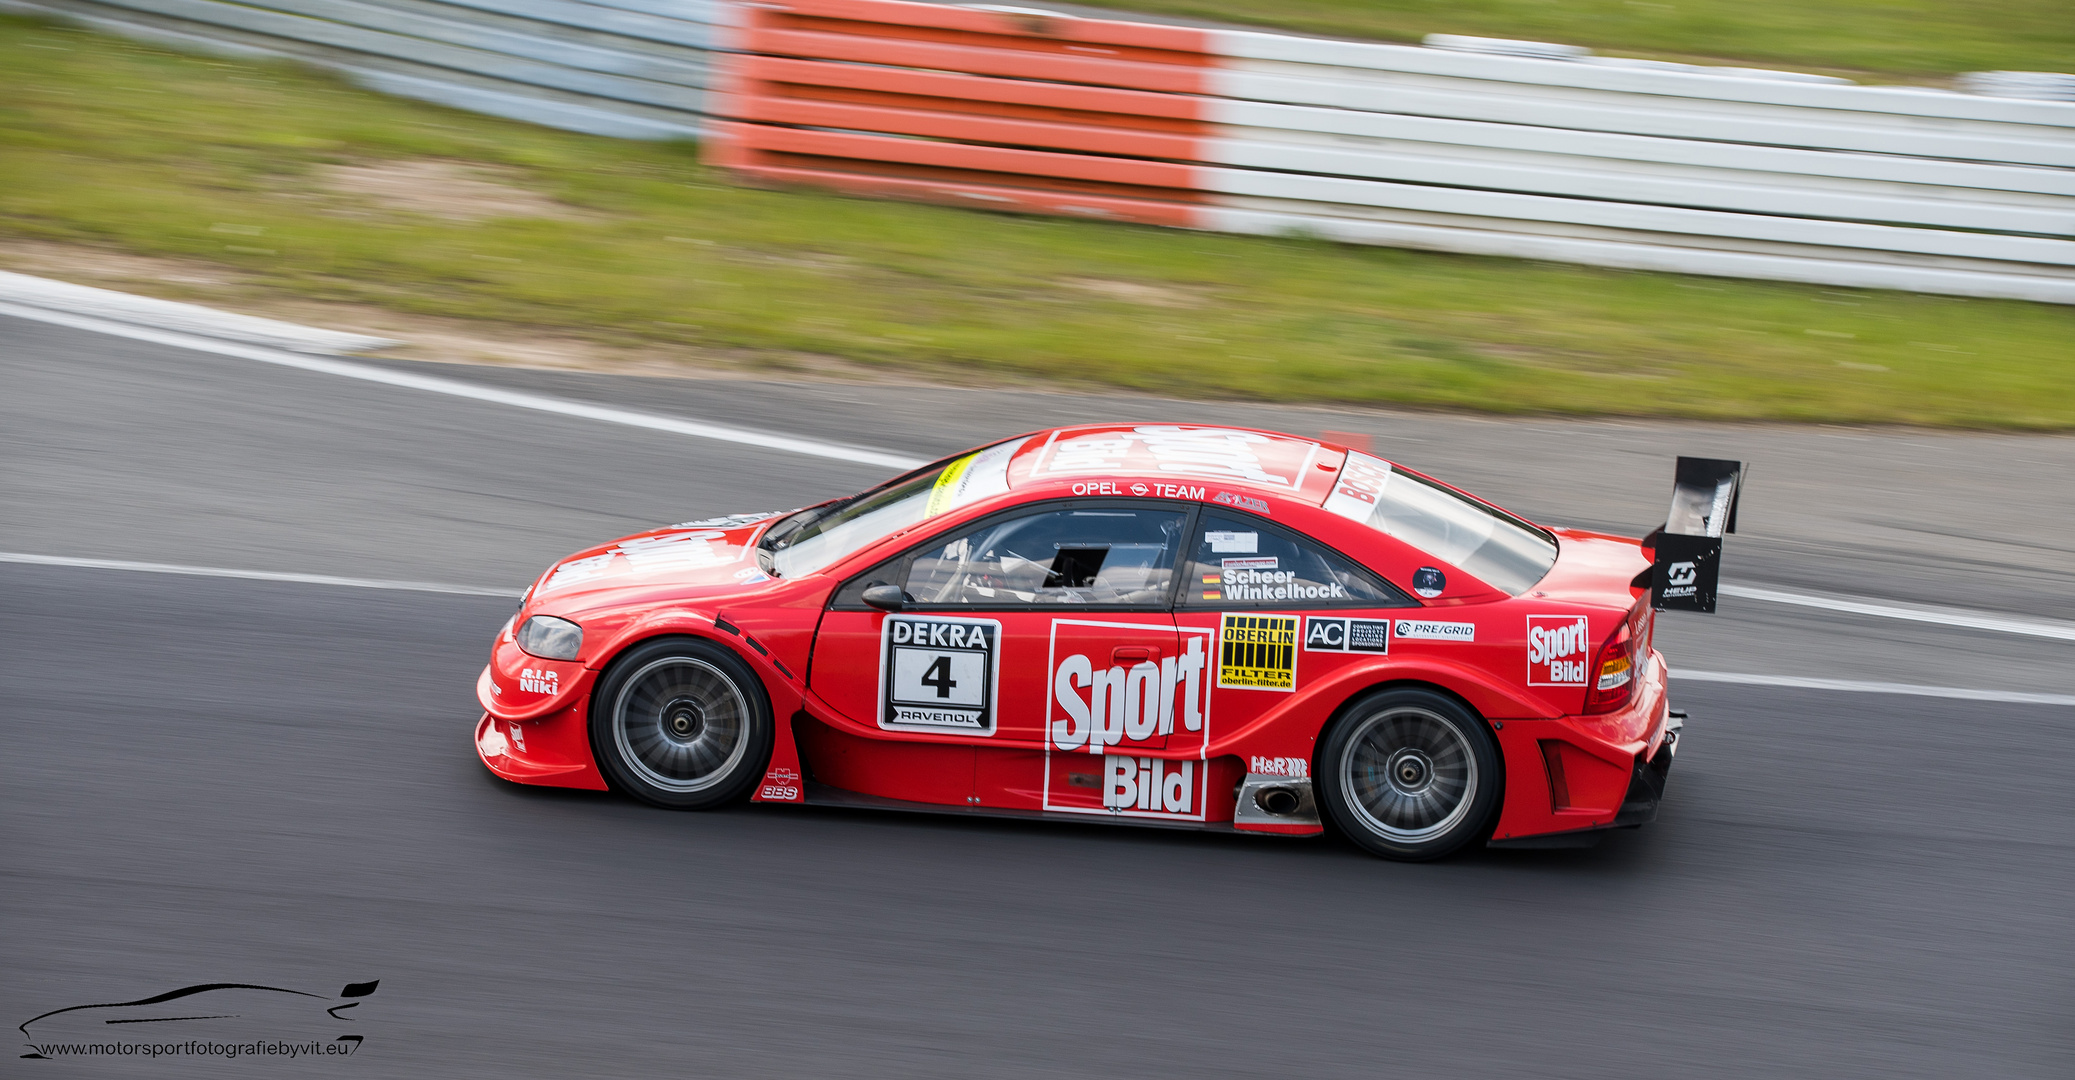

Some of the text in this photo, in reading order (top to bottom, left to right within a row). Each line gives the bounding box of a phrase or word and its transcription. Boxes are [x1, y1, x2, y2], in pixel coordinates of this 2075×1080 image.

[1339, 457, 1387, 504] BOSCH
[1071, 482, 1206, 500] OPEL TEAM
[1223, 568, 1296, 585] Scheer
[1224, 582, 1344, 600] Winkelhock
[1663, 586, 1698, 595] HEUP
[892, 621, 988, 649] DEKRA
[1224, 628, 1294, 645] OBERLIN
[1307, 622, 1344, 646] AC
[1414, 624, 1474, 636] PRE/GRID
[1530, 618, 1586, 666] Sport
[521, 668, 558, 682] R.I.P.
[920, 655, 958, 699] 4
[1222, 668, 1292, 680] FILTER
[1550, 660, 1585, 683] Bild
[519, 678, 558, 696] Niki
[1221, 677, 1291, 688] oberlin-filter.de
[1051, 636, 1206, 755] Sport
[901, 710, 975, 724] RAVENOL
[761, 785, 798, 800] BBS
[1102, 754, 1194, 814] Bild
